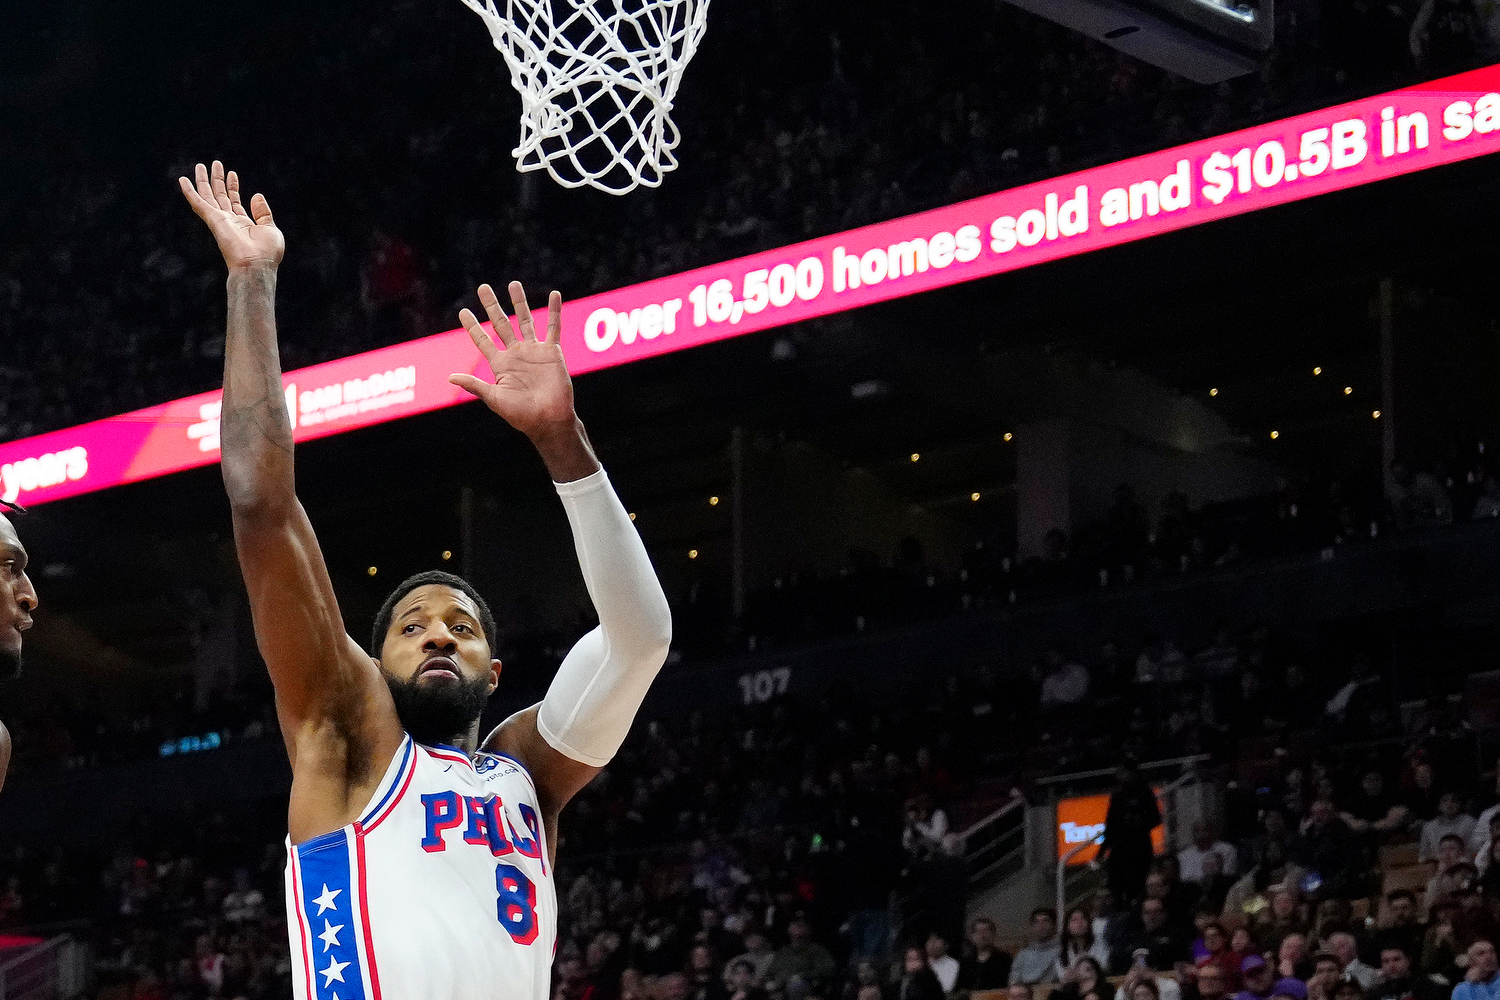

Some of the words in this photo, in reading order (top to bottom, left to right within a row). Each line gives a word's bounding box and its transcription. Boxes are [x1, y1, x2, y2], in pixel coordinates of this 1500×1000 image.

[584, 298, 682, 352] Over
[689, 257, 823, 327] 16,500
[832, 224, 982, 293] homes
[990, 184, 1089, 253] sold
[1099, 158, 1191, 228] and
[1202, 118, 1367, 204] $10.5B
[1381, 106, 1429, 157] in
[1, 446, 88, 504] years
[738, 665, 791, 704] 107
[495, 863, 539, 946] 8
